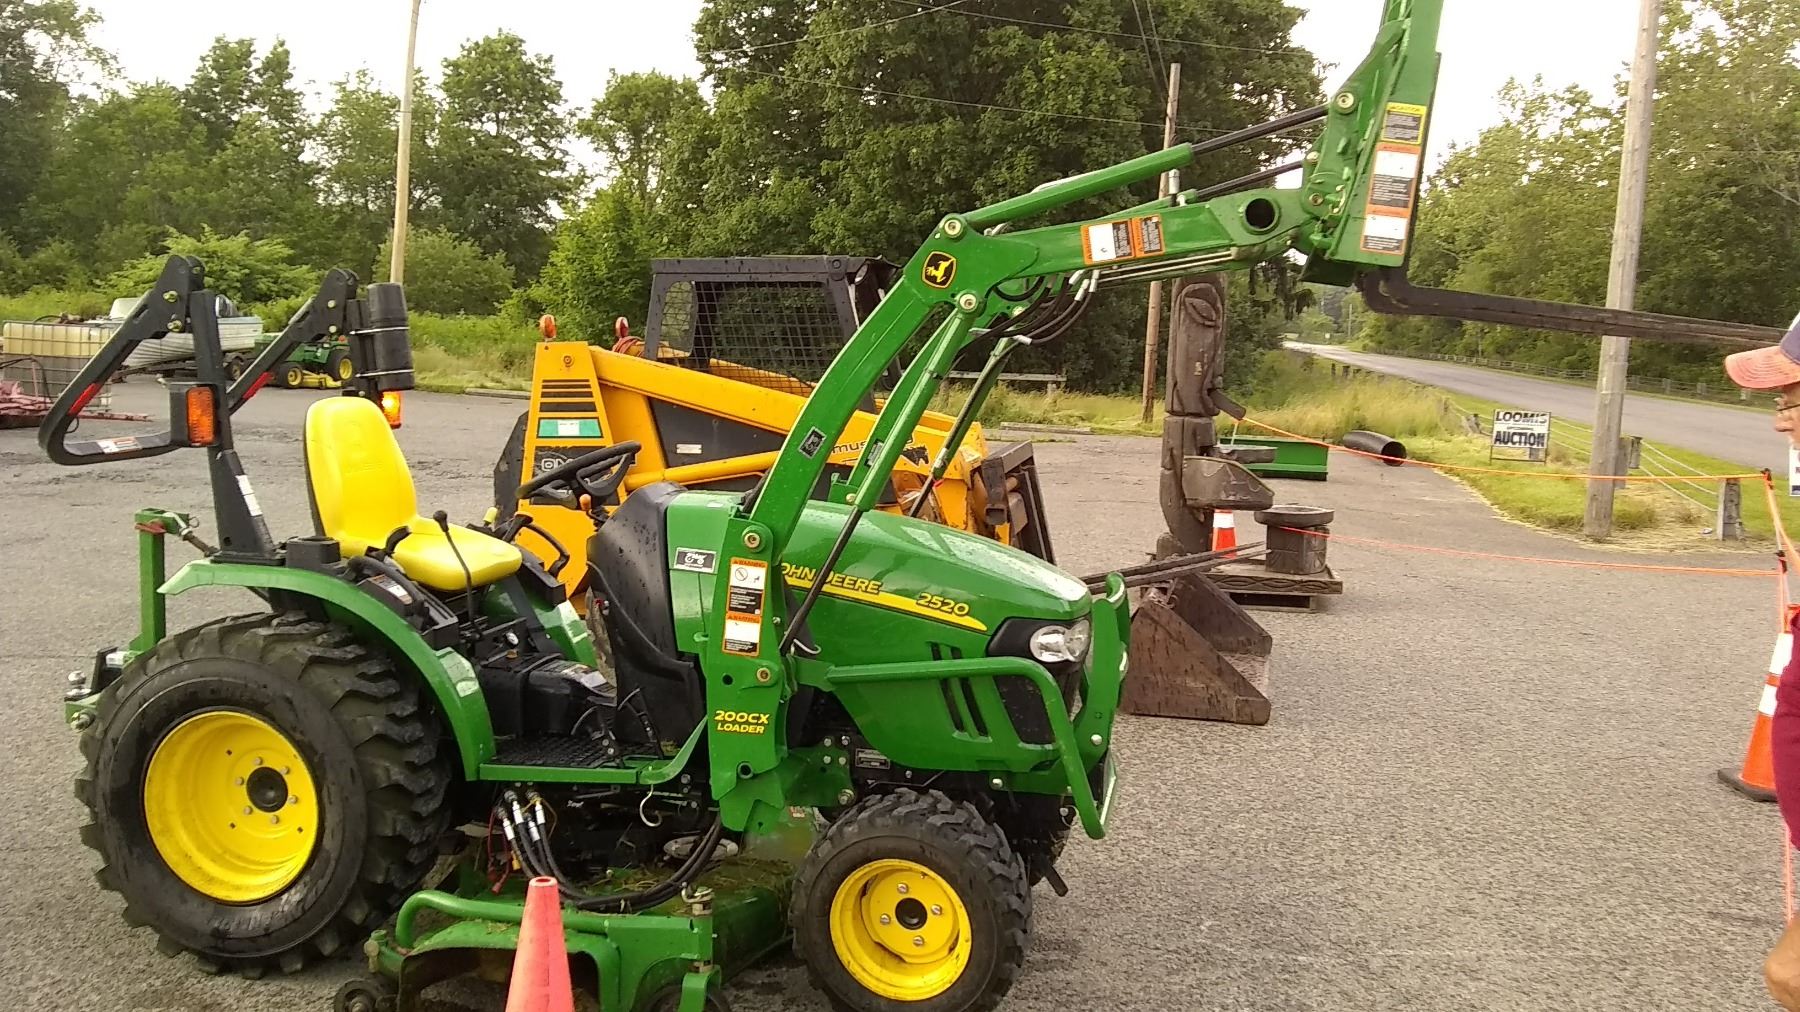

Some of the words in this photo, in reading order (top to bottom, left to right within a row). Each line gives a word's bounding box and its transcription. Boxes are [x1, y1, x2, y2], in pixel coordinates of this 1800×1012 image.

[1496, 411, 1547, 424] LOOMIS
[1494, 431, 1545, 447] AUCTION
[781, 562, 816, 580] OHN
[917, 593, 970, 615] 2520
[714, 710, 770, 724] 200CX
[717, 723, 765, 734] LOADER
